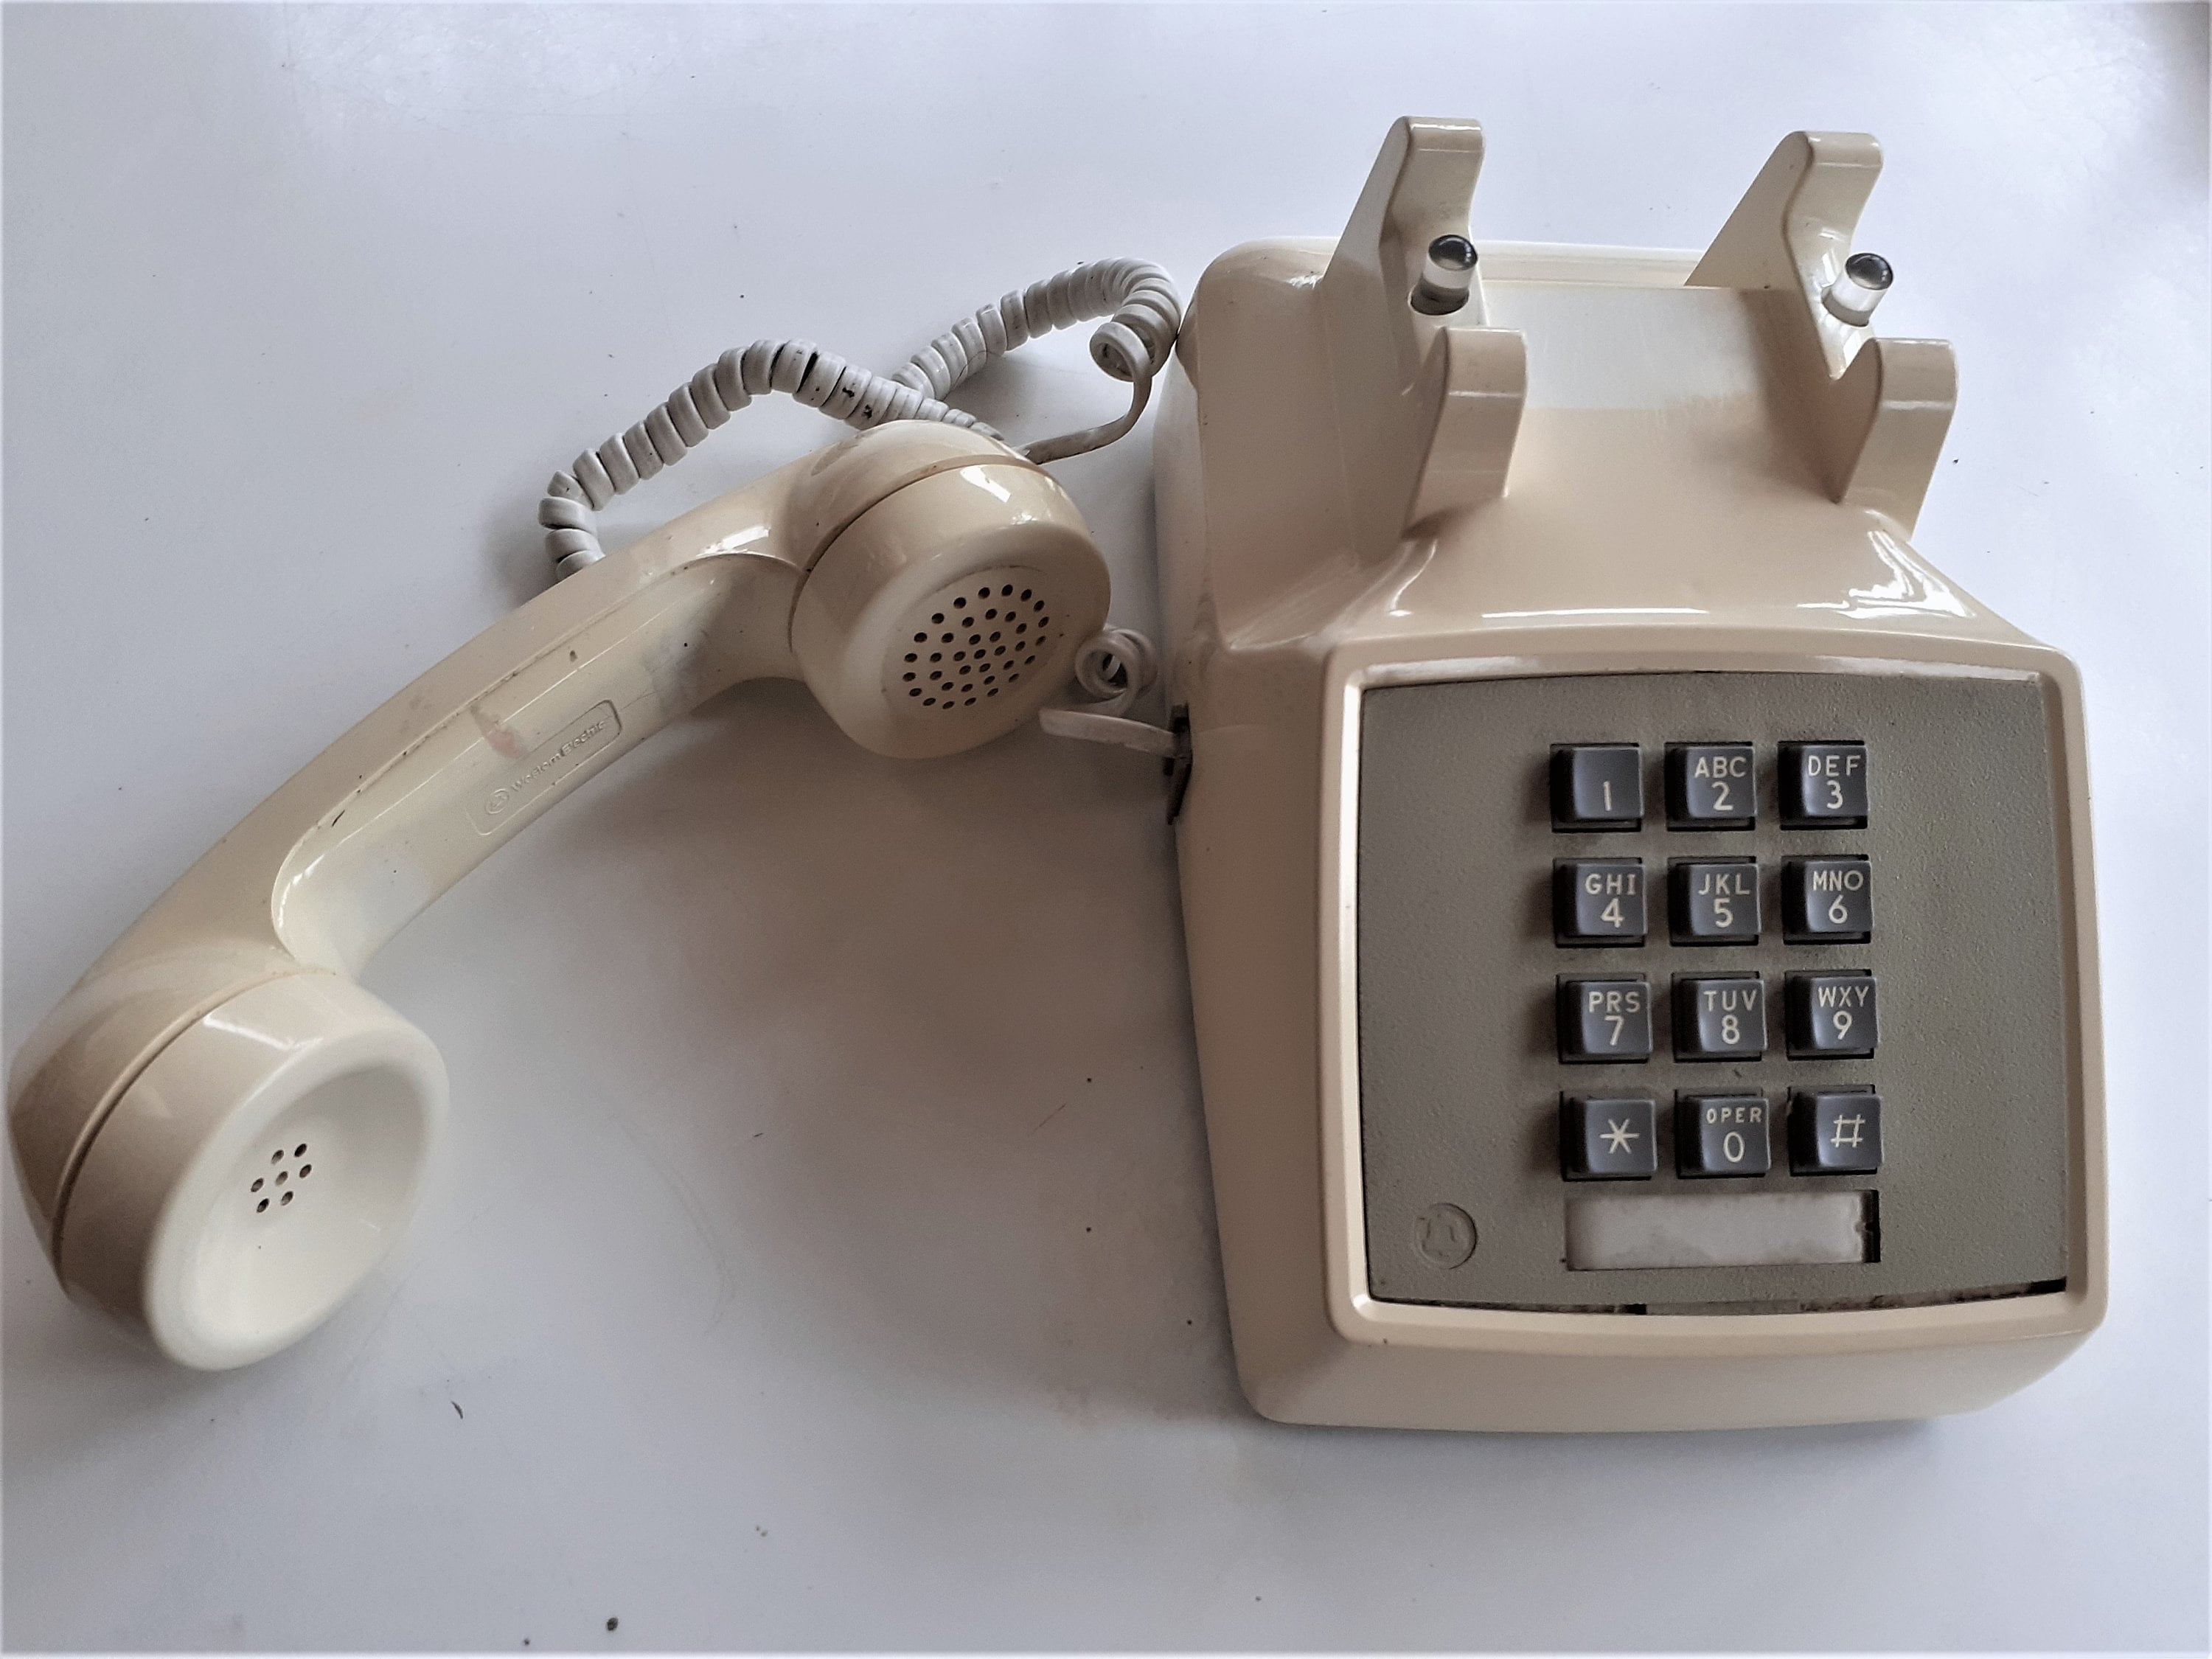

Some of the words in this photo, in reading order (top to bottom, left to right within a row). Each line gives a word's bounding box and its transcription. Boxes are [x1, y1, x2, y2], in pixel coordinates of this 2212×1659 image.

[1694, 756, 1747, 779] ABC
[1807, 754, 1862, 777] DEF
[1603, 780, 1613, 812] 1
[1711, 781, 1733, 812] 2
[1826, 780, 1844, 810] 3
[1585, 873, 1636, 896] GHI
[1697, 873, 1750, 896] JKL
[1812, 870, 1863, 892] MNO
[1600, 897, 1624, 929] 4
[1713, 897, 1733, 928] 5
[1828, 894, 1848, 925] 6
[1587, 991, 1641, 1014] PRS
[1703, 989, 1758, 1012] TUV
[1818, 985, 1870, 1008] WXY
[1604, 1015, 1625, 1046] 7
[1720, 1014, 1741, 1046] 8
[1832, 1010, 1853, 1040] 9
[1705, 1106, 1762, 1125] OPER
[1829, 1113, 1865, 1148] #
